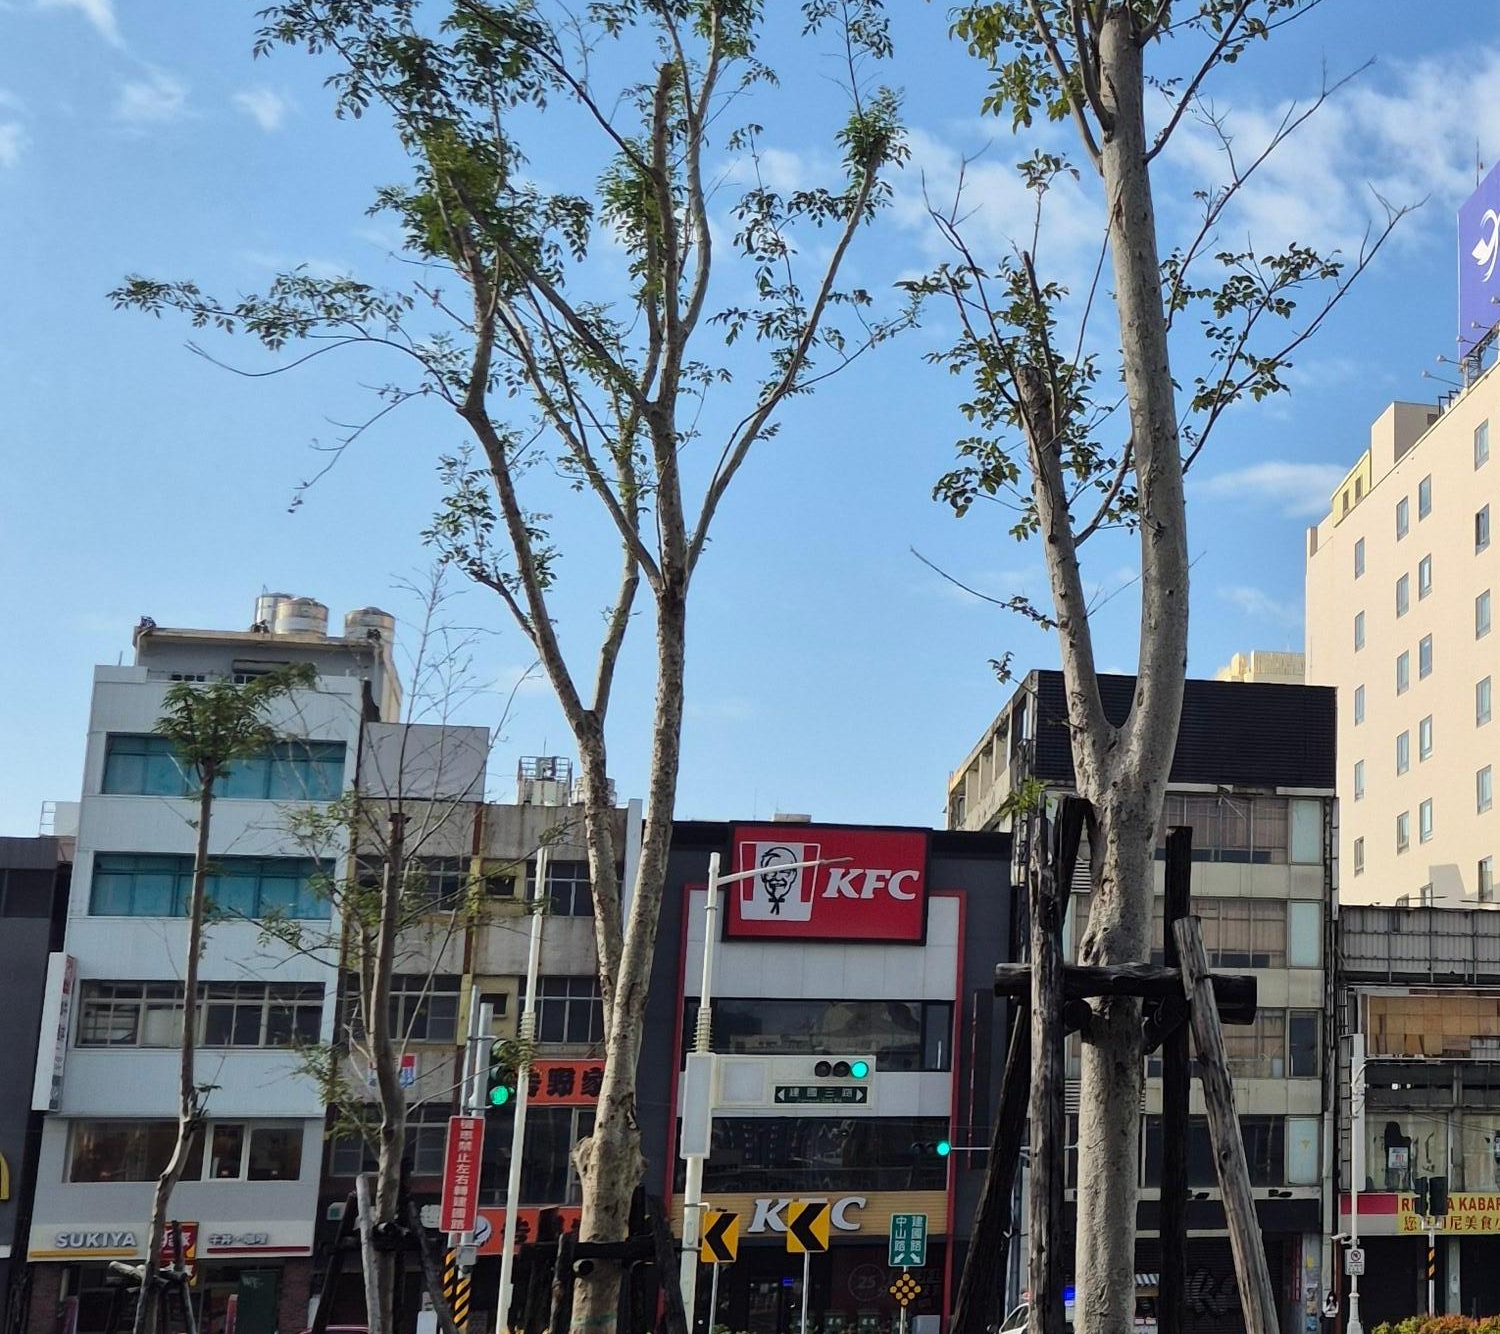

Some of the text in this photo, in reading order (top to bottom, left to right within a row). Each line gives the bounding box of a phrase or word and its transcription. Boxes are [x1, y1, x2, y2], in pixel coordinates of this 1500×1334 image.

[822, 868, 920, 900] KFC
[747, 1196, 866, 1233] KC
[55, 1231, 137, 1249] SUKIYA
[894, 1216, 907, 1252] 中山路
[911, 1216, 924, 1252] 建國路
